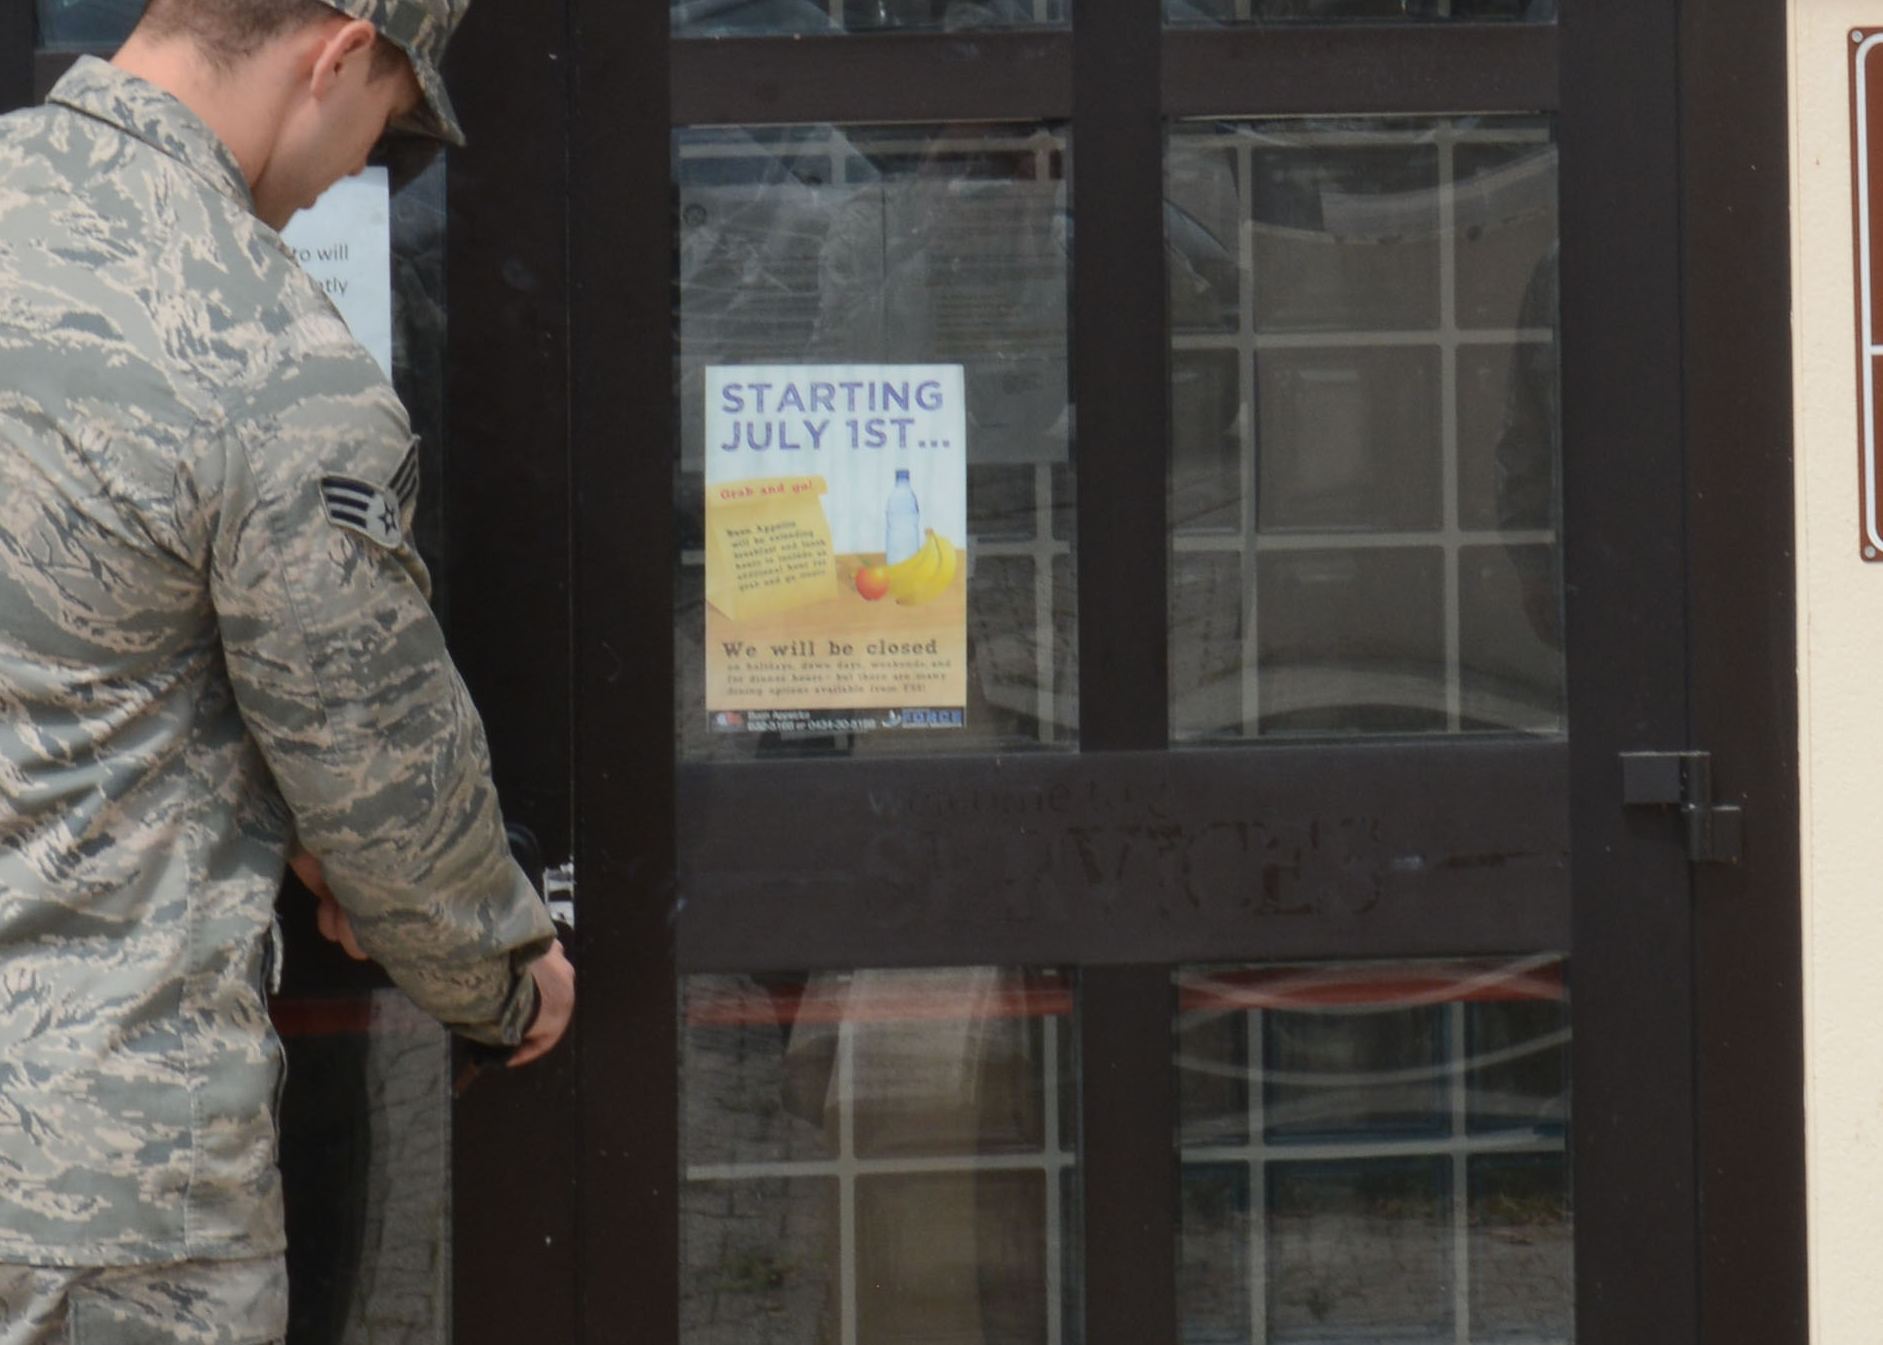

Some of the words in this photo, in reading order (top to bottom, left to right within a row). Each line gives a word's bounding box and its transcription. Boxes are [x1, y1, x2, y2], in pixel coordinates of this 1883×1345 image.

[317, 241, 348, 261] will
[720, 379, 945, 414] STARTING
[720, 418, 830, 452] JULY
[845, 417, 952, 450] 1ST...
[719, 486, 754, 500] Grab
[761, 482, 785, 495] and
[722, 641, 759, 657] We
[769, 639, 817, 657] will
[827, 638, 854, 656] be
[865, 638, 938, 656] closed
